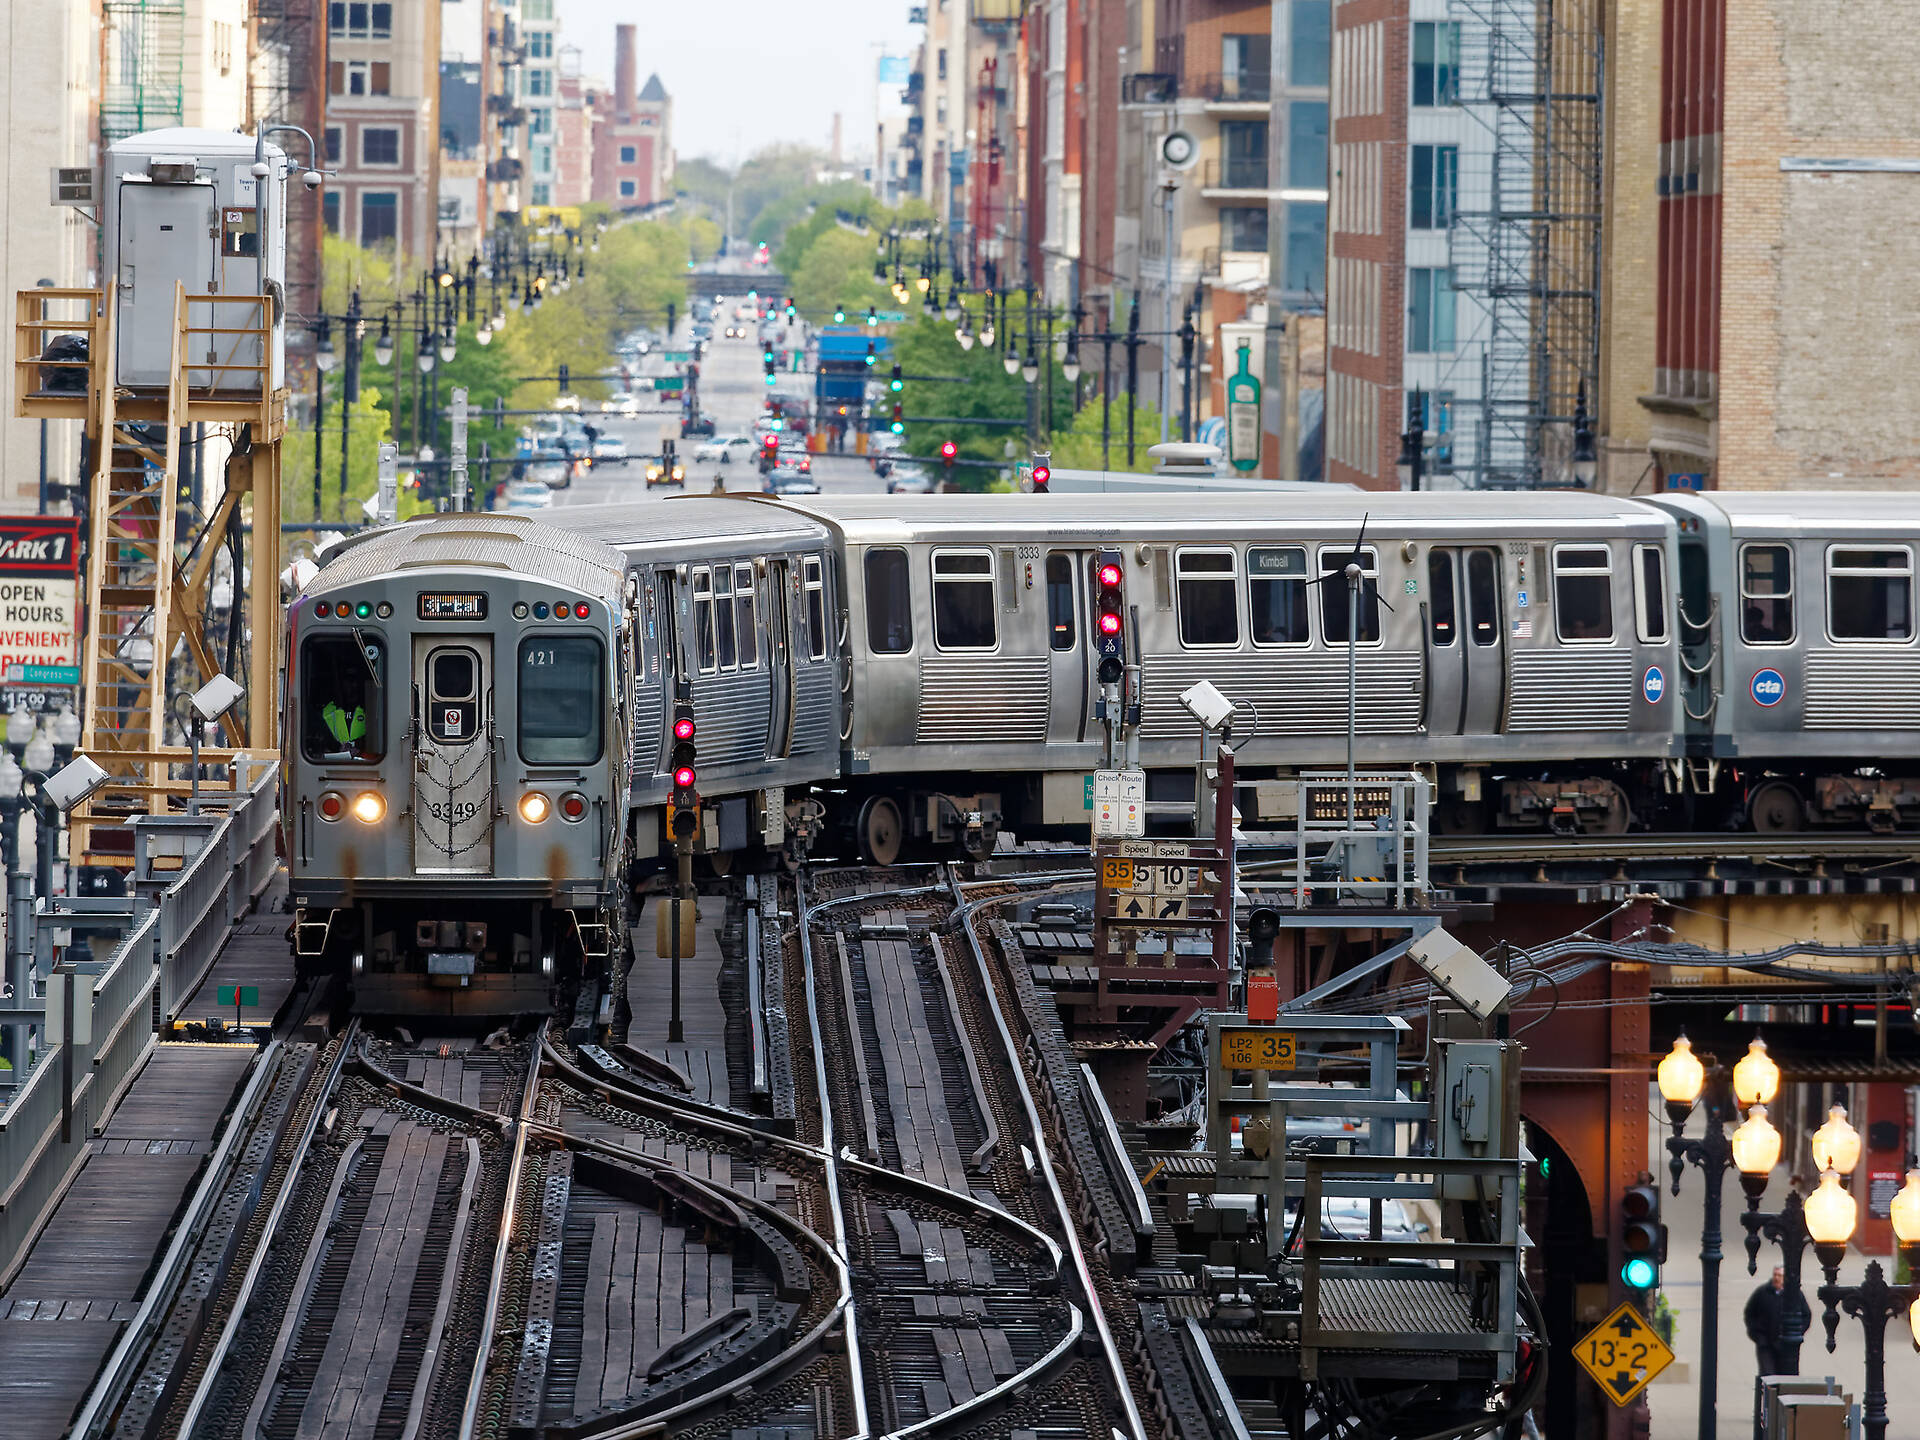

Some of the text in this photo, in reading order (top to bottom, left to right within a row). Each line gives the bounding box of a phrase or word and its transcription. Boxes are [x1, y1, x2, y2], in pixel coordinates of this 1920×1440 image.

[0, 536, 66, 560] ARK 1
[1018, 546, 1040, 559] 3333
[1509, 542, 1529, 555] 3333
[1259, 555, 1289, 568] Kimball
[0, 585, 45, 601] OPEN
[6, 606, 64, 622] HOURS
[1105, 645, 1116, 653] 20
[527, 651, 555, 665] 421
[1646, 677, 1662, 691] cta
[1755, 680, 1781, 694] cta
[1097, 774, 1142, 783] Check Route
[432, 802, 475, 818] 3349
[1124, 845, 1149, 855] Speed
[1160, 848, 1185, 857] Speed
[1106, 862, 1130, 878] 35
[1132, 865, 1150, 882] 5
[1159, 866, 1184, 885] 10
[1229, 1038, 1253, 1049] LP2
[1262, 1037, 1291, 1058] 35
[1230, 1053, 1252, 1063] 106
[1274, 1058, 1294, 1066] signal
[1590, 1340, 1658, 1369] 13'-2"
